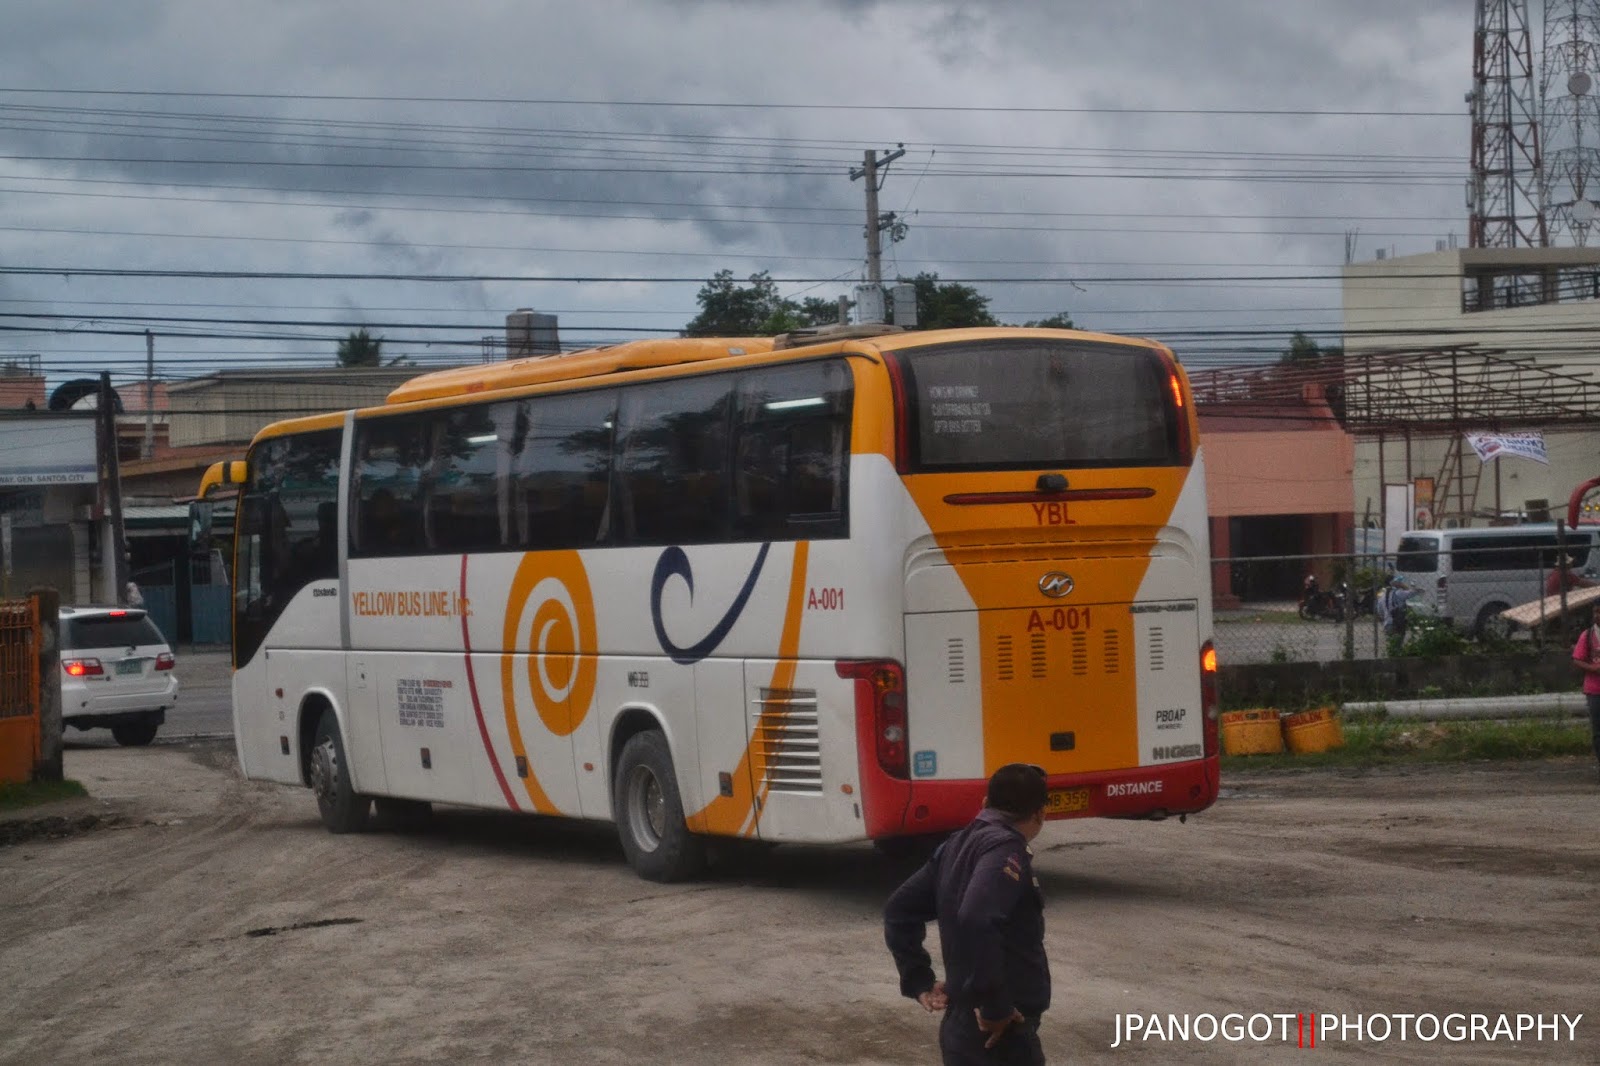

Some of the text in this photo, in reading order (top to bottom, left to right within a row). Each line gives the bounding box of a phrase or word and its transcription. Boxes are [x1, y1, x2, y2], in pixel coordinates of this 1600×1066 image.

[36, 474, 67, 482] SANTOS
[68, 473, 85, 481] CITY
[1032, 502, 1076, 525] YBL
[353, 591, 395, 615] YELLOW
[399, 591, 421, 616] BUS
[807, 587, 844, 610] A-001
[1027, 606, 1091, 632] A-001
[1107, 780, 1163, 797] DISTANCE
